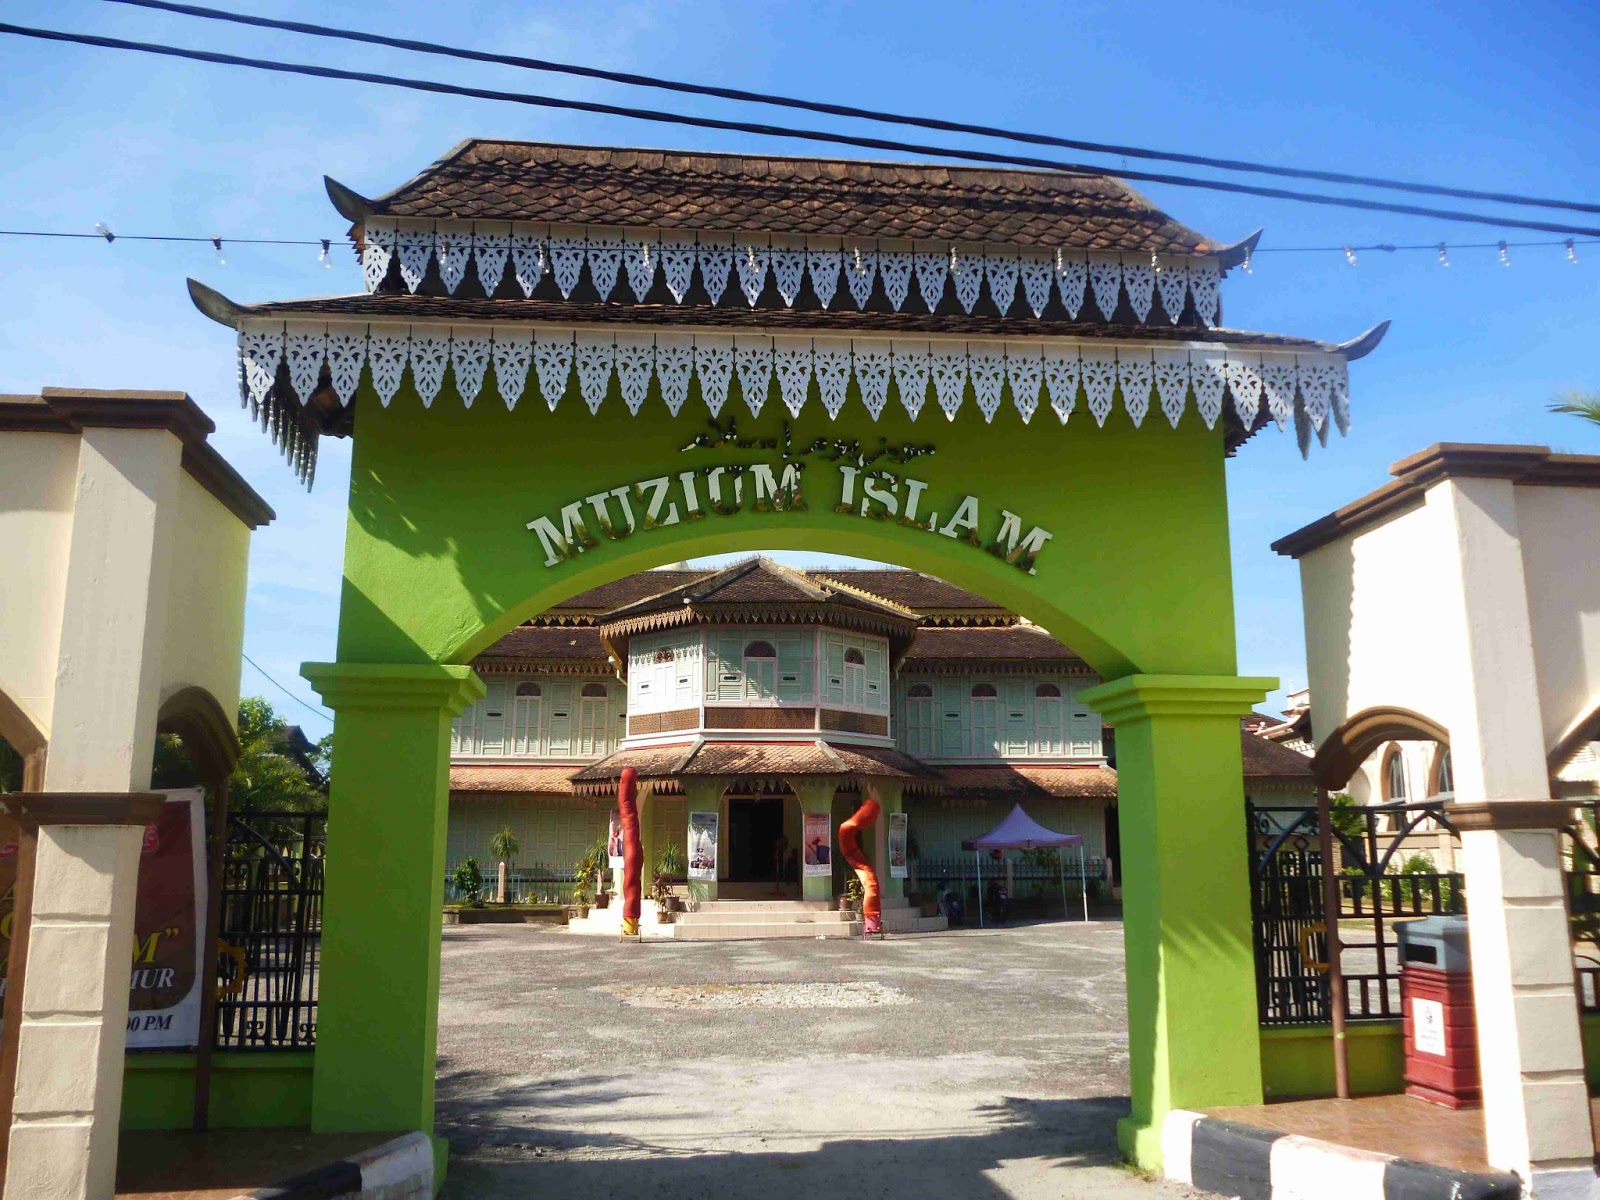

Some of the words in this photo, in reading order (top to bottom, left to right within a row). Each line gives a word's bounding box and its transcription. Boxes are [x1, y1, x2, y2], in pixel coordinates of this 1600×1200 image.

[526, 463, 808, 567] MUZIUM
[836, 465, 1053, 575] ISLAM
[142, 1014, 174, 1031] PM
